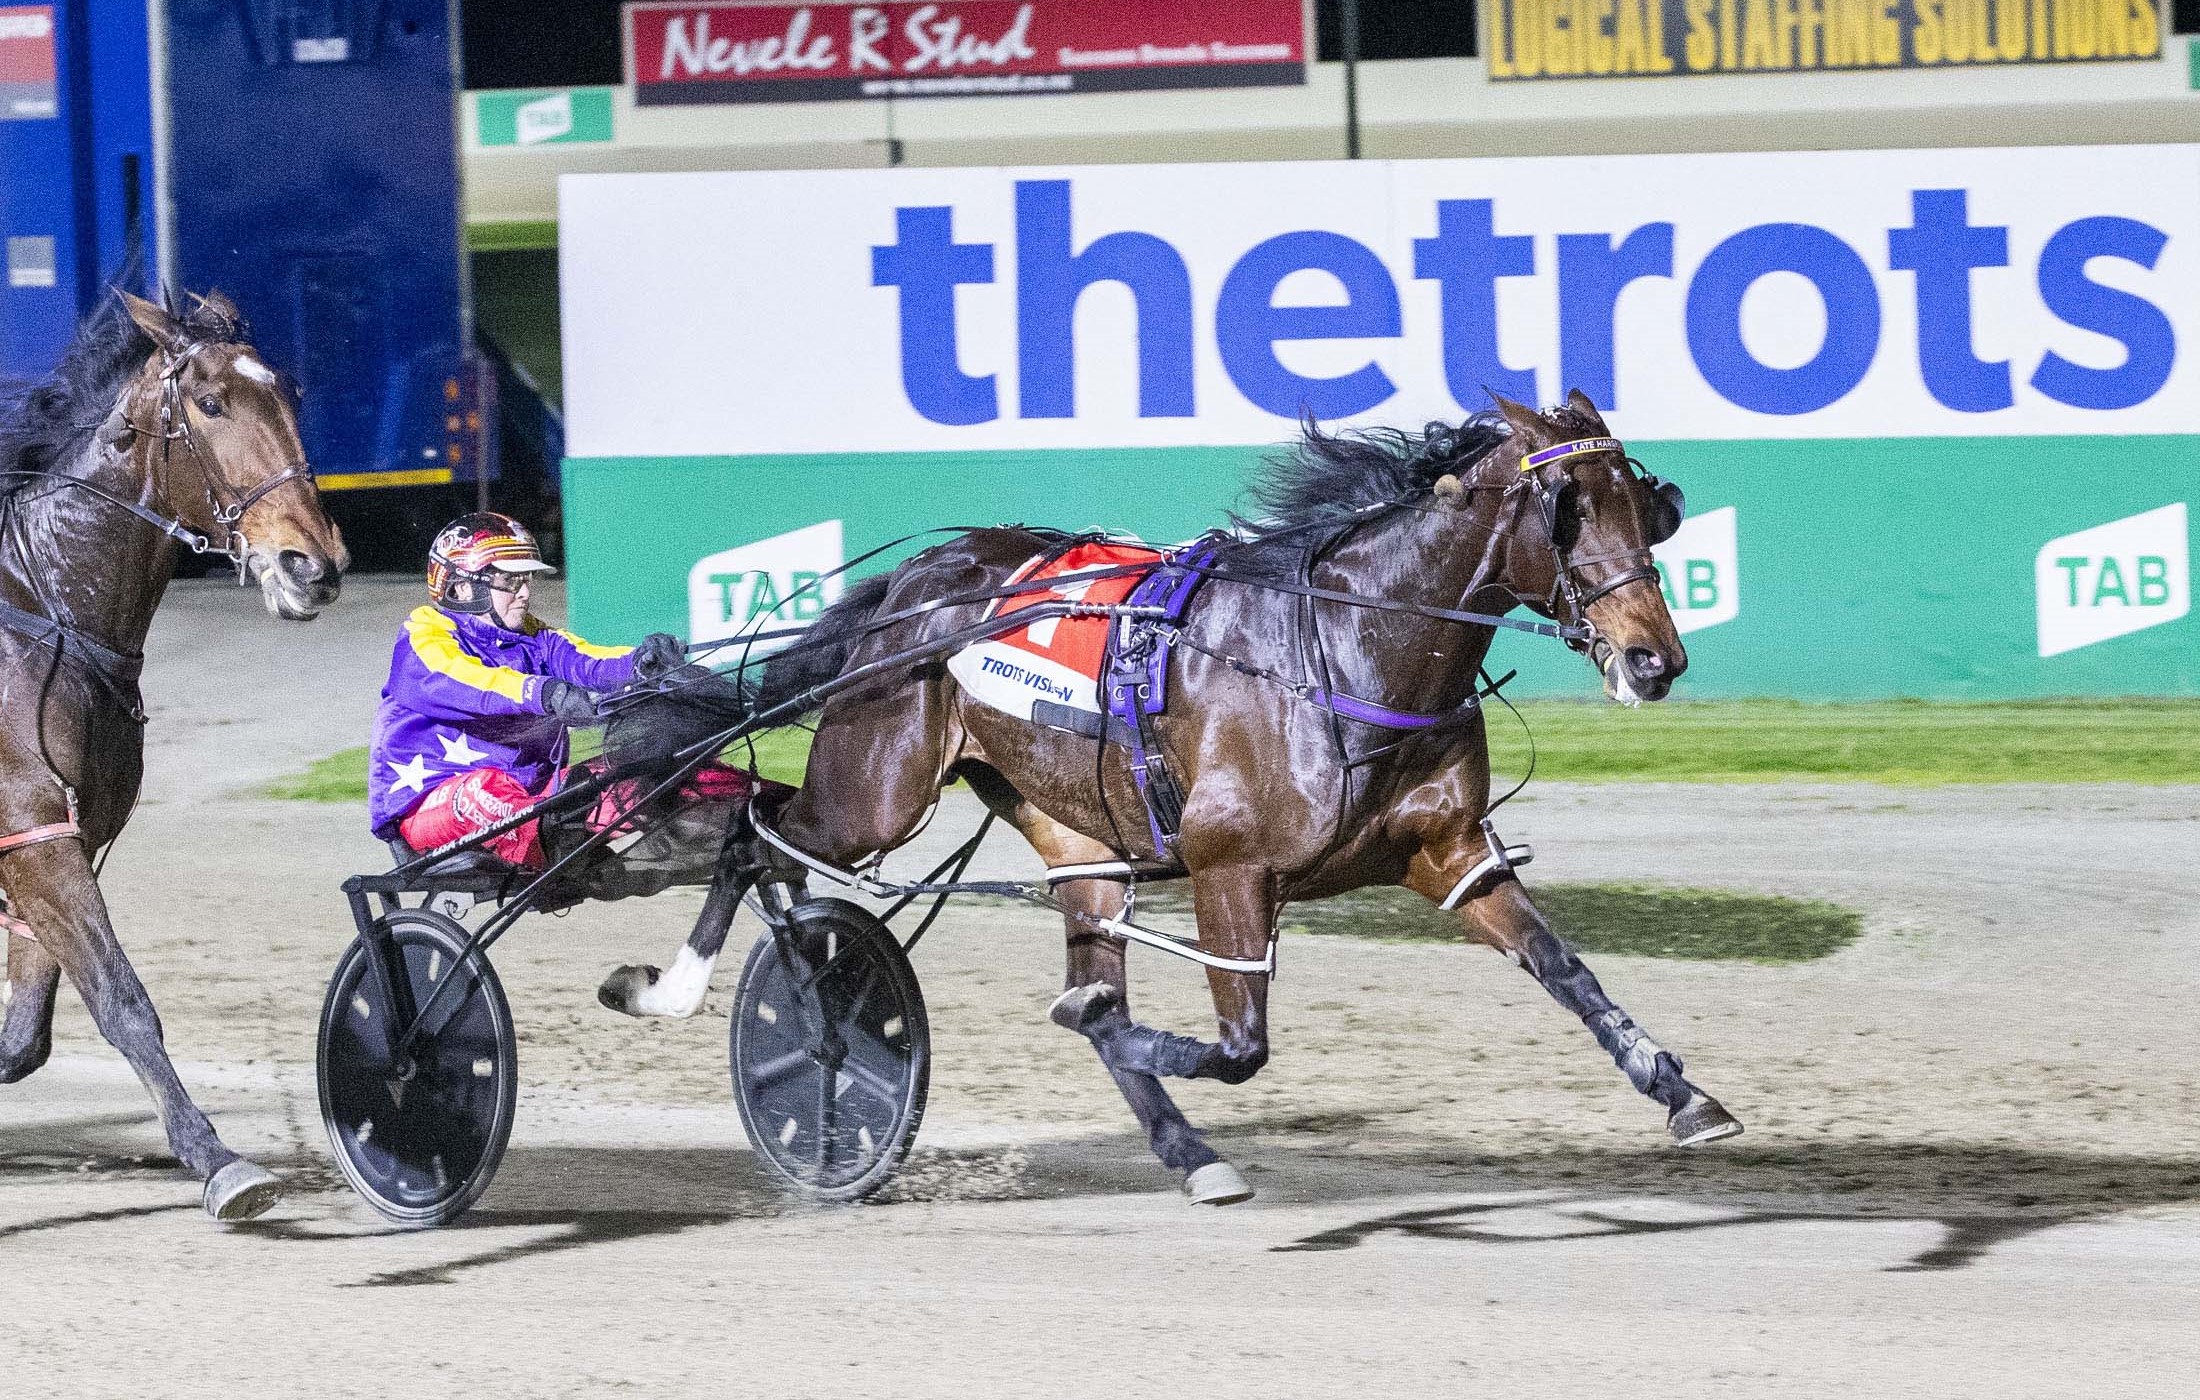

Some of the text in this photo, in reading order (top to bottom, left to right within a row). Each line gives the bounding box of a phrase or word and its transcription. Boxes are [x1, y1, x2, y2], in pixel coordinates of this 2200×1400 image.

[659, 5, 1036, 79] Nevele R Stud
[1489, 0, 2161, 77] LOGICAL STAFFING SOLUTIONS
[870, 178, 2177, 426] thetrots
[1571, 441, 1595, 452] KATE
[708, 570, 825, 622] TAB
[1655, 559, 1719, 609] AB
[2056, 555, 2170, 607] TAB
